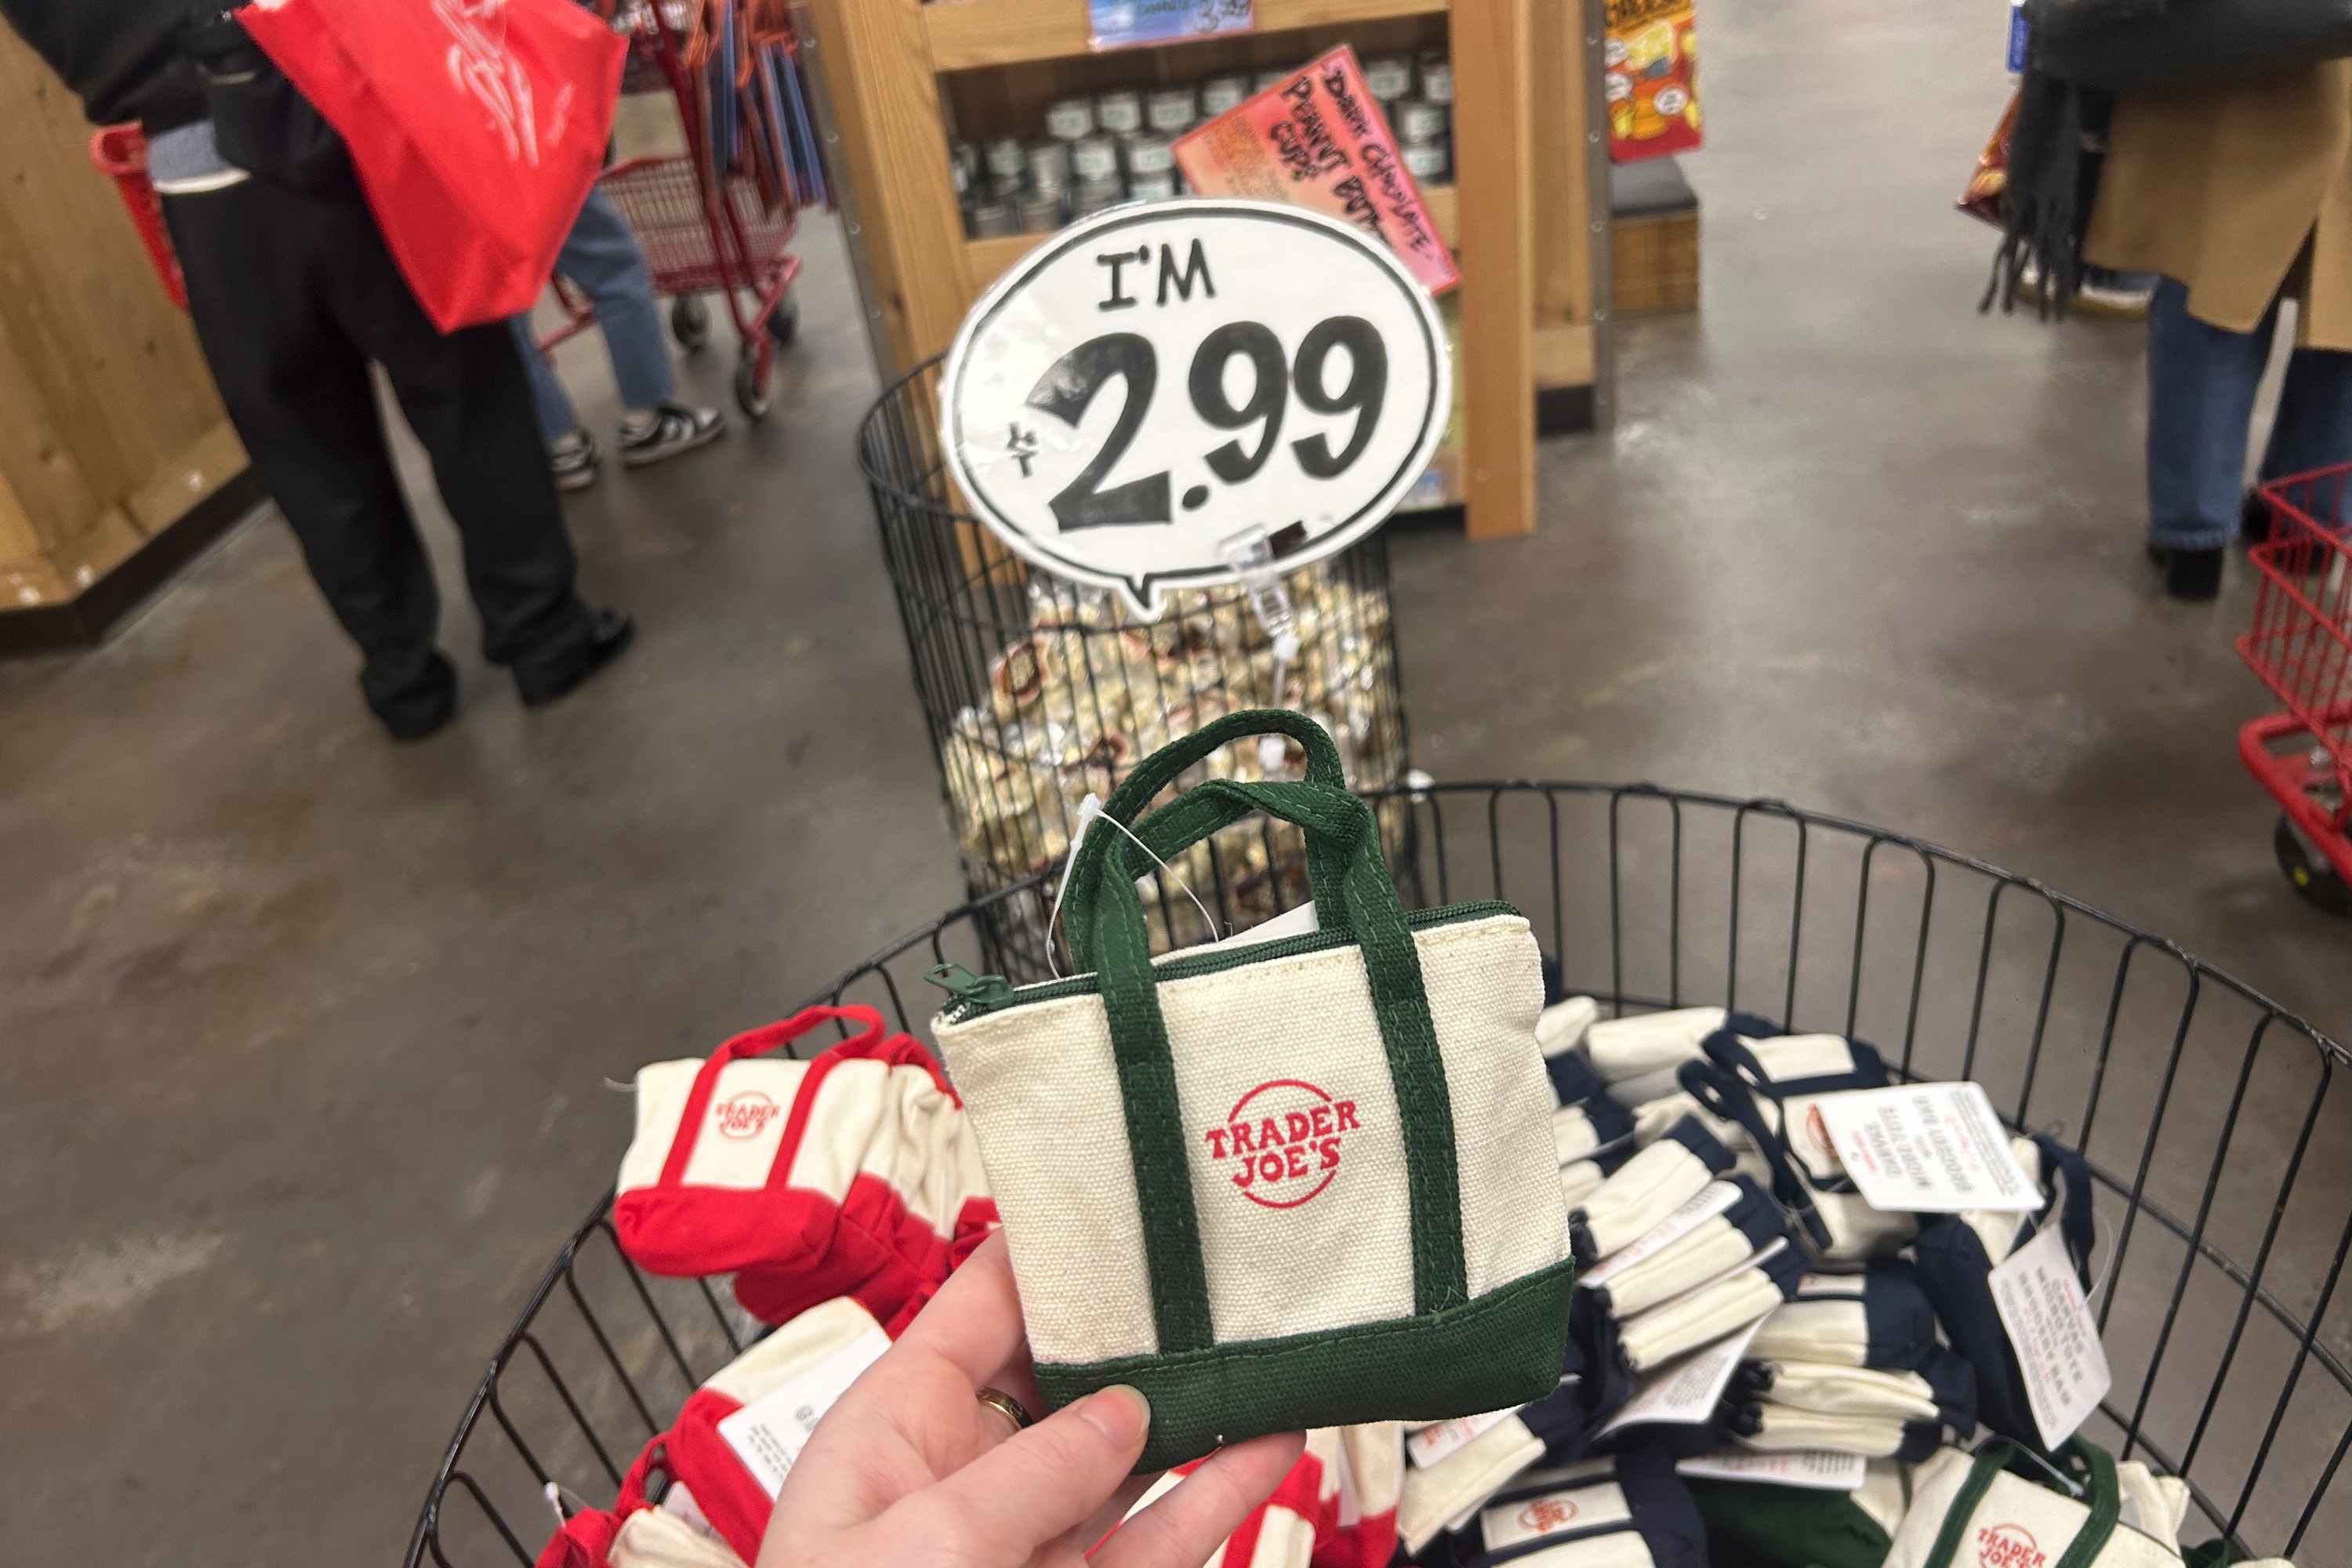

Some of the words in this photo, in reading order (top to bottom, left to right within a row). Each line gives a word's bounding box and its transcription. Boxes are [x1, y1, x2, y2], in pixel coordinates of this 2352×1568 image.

[1279, 75, 1349, 172] PEANUT
[1098, 238, 1216, 310] I'M
[1205, 1100, 1361, 1160] TRADER
[1232, 1137, 1341, 1188] JOE'S
[1977, 1527, 2047, 1566] TRADER
